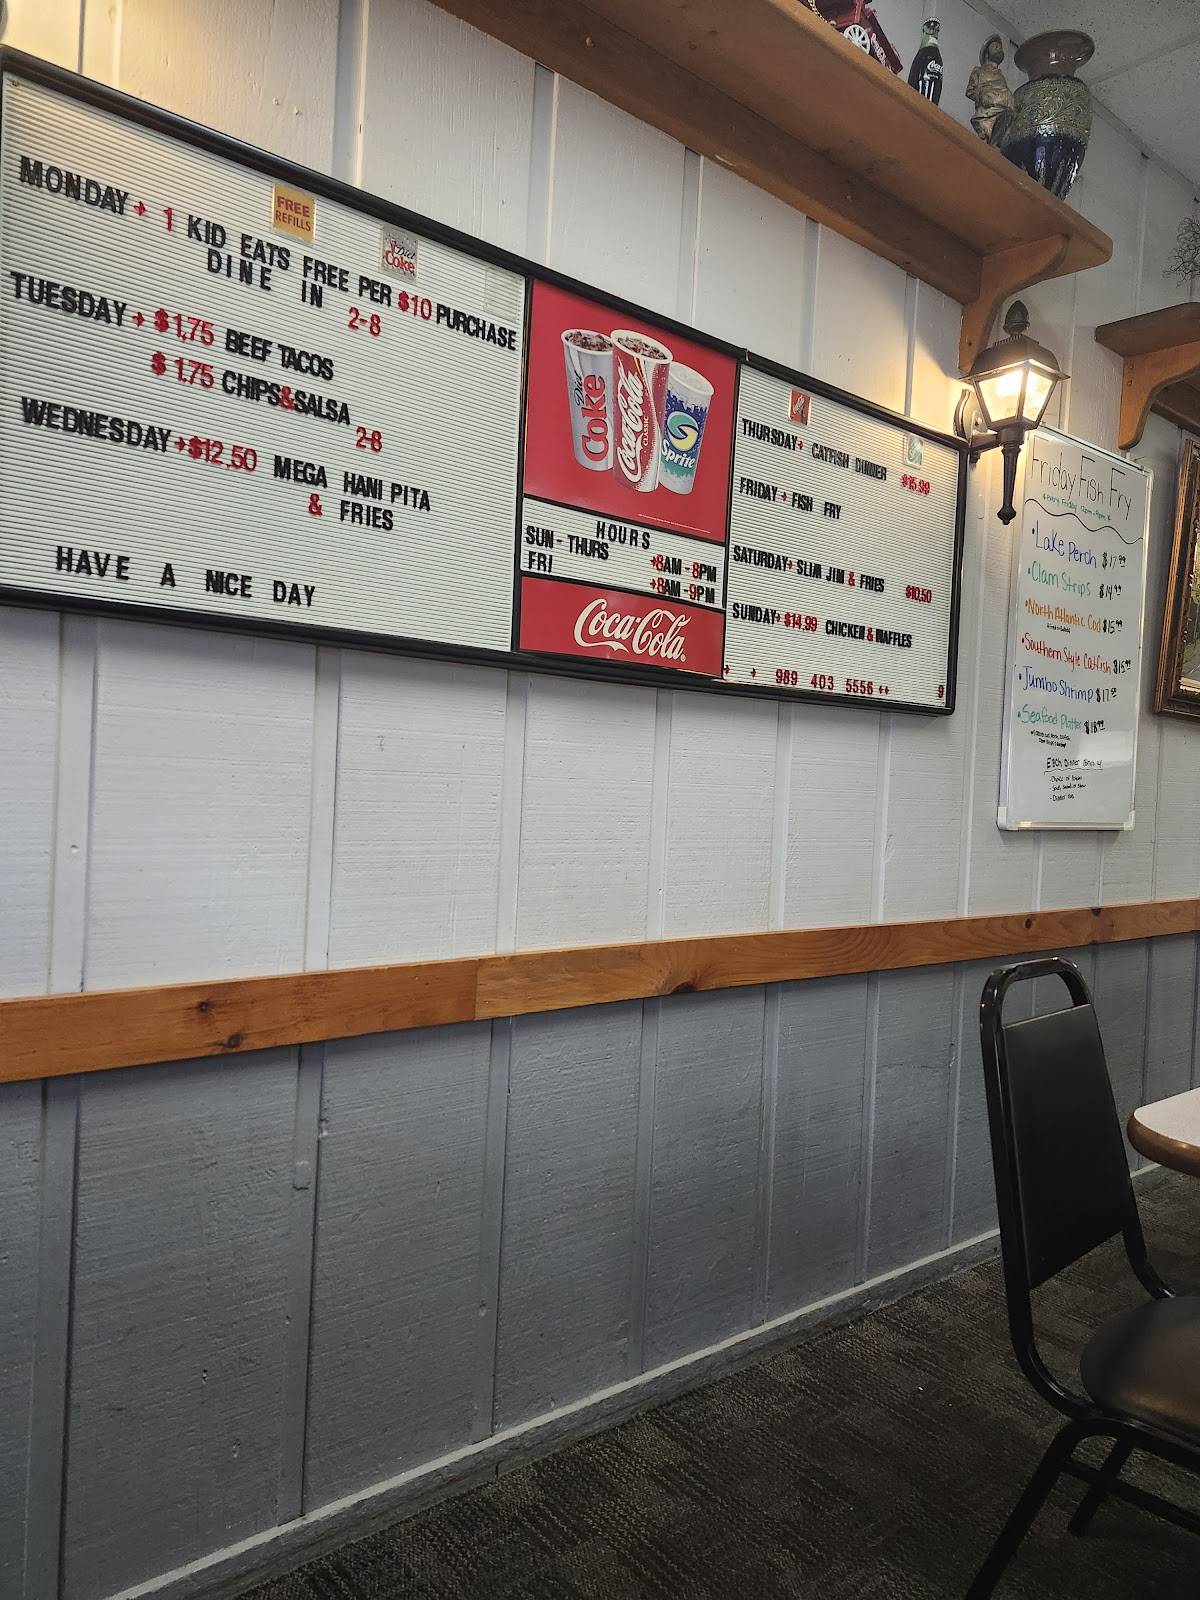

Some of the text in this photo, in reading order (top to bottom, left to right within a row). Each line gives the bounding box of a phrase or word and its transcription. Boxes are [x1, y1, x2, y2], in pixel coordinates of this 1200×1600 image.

[275, 210, 312, 232] REFILLS
[276, 195, 311, 218] FREE
[20, 155, 517, 351] MONDAY 1 KID EATS FREE PER $10 PURCHASE
[384, 240, 415, 273] Coke
[207, 248, 382, 337] DINE IN 2-8
[10, 271, 127, 326] TUESDAY
[225, 328, 272, 362] BEEF
[278, 343, 334, 381] TACOS
[579, 374, 609, 462] Coke
[21, 396, 431, 512] WEDNESDAY $12.50 MEGA HANI PITA
[355, 425, 383, 453] 2-8
[661, 439, 696, 469] Sprite
[741, 418, 798, 451] THURSDAY
[811, 443, 850, 469] CATFISH
[855, 457, 887, 481] DINNER
[739, 476, 842, 520] FRIDAY FISH FRY
[1031, 436, 1132, 521] Friday Fish Fry
[308, 492, 394, 531] & FRIES
[567, 534, 610, 560] THURS
[596, 520, 651, 550] HOURS
[1035, 520, 1065, 557] Lake
[1068, 541, 1098, 569] Perch
[55, 545, 316, 607] HAVE A NICE DAY
[528, 551, 553, 573] FRI
[732, 545, 789, 572] SATURDAY
[796, 559, 822, 579] SLIM
[826, 566, 845, 584] JIM
[847, 570, 856, 587] &
[859, 574, 885, 593] FRIES
[1032, 560, 1059, 587] Clam
[1061, 572, 1091, 598] Strips
[574, 598, 692, 663] Coca-Cola
[732, 602, 777, 625] SUNDAY
[825, 619, 865, 641] CHICKEN
[866, 626, 874, 642] &
[875, 628, 912, 648] WAFFLES
[1027, 598, 1054, 621] North
[1055, 606, 1086, 627] Atlantic
[1088, 614, 1101, 633] Cod
[1024, 632, 1062, 660] Southern
[1063, 647, 1081, 672] Style
[1084, 653, 1111, 675] Catfish
[775, 668, 798, 686] 989
[810, 674, 834, 691] 403
[1022, 665, 1058, 692] Jumbo
[1059, 679, 1094, 703] Shrimp
[1021, 704, 1058, 726] Seafood
